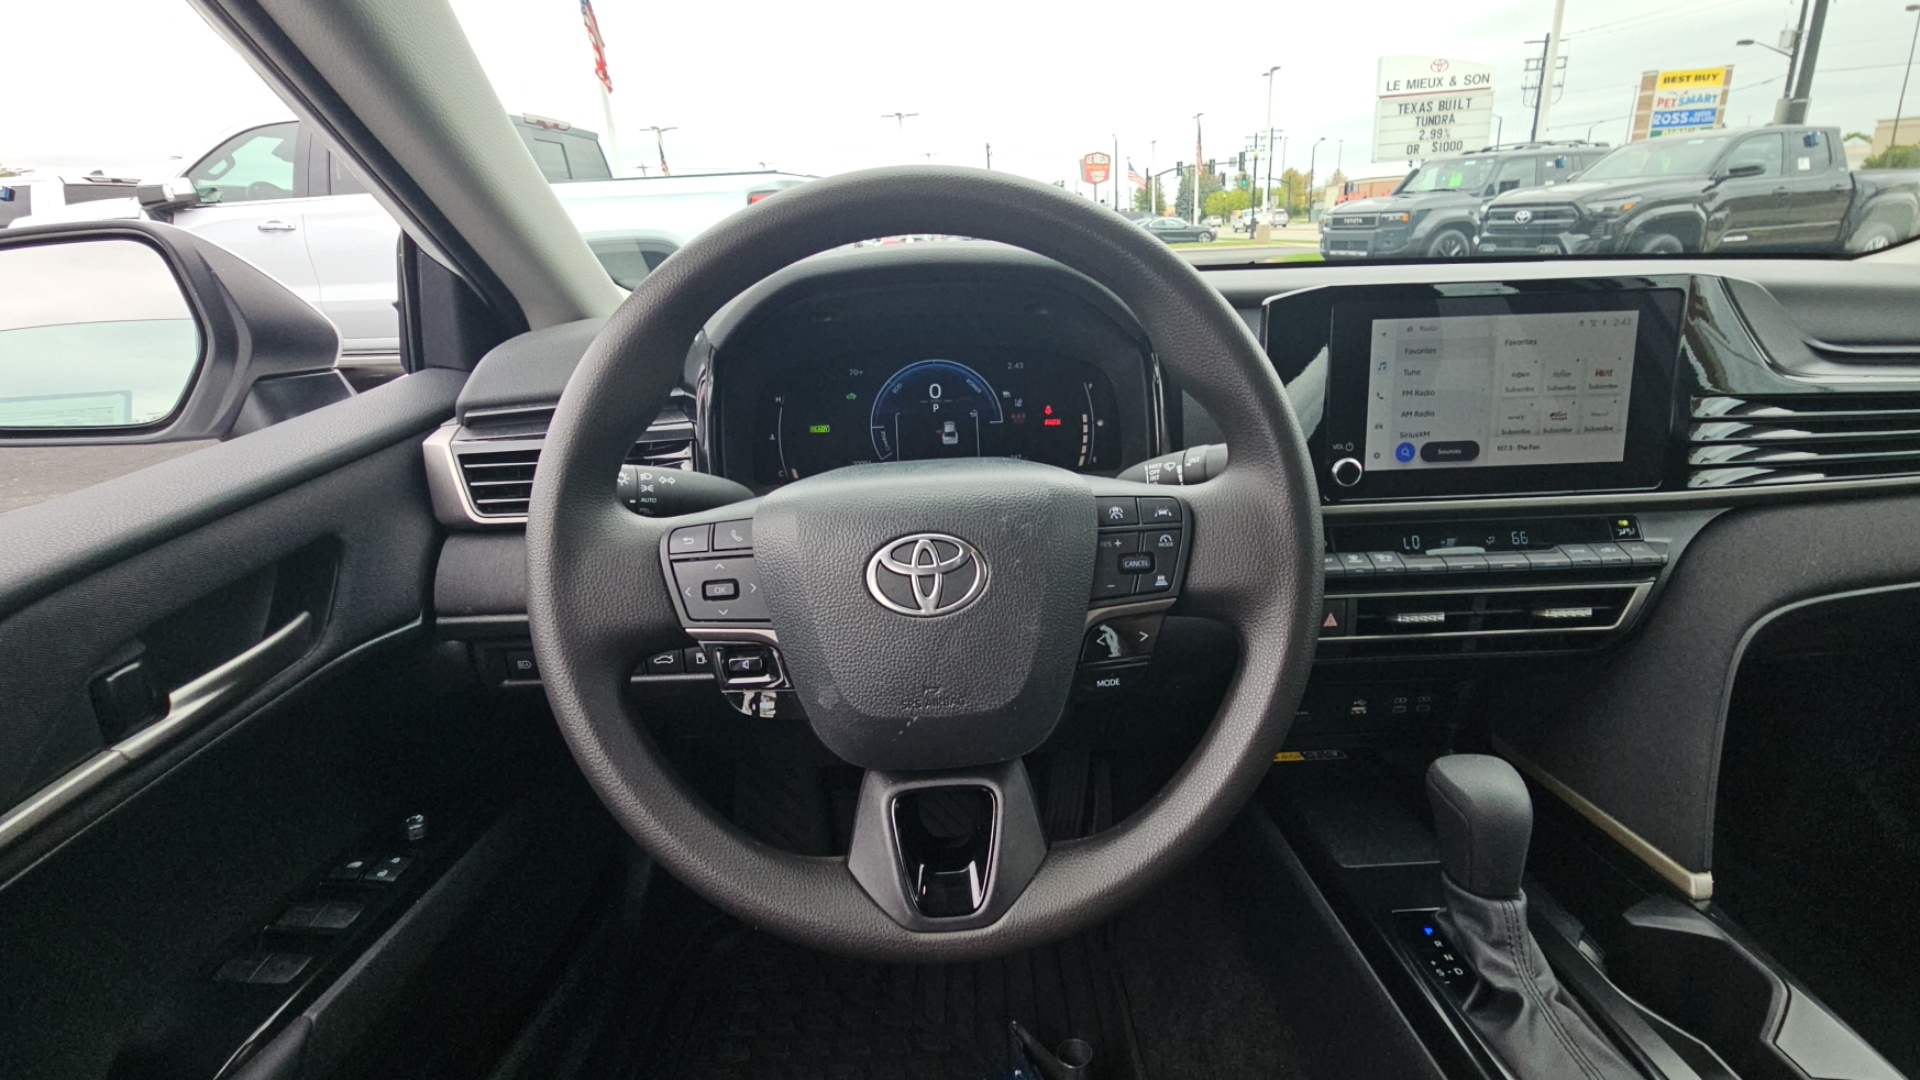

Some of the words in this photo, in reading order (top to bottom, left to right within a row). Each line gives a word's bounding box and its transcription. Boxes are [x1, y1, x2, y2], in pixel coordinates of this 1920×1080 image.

[1386, 80, 1401, 92] LE
[1406, 76, 1444, 90] MIEUX
[1449, 76, 1457, 87] &
[1463, 73, 1491, 86] SON
[1663, 74, 1692, 84] BEST
[1693, 72, 1719, 82] BUY
[1398, 100, 1433, 115] TEXAS
[1438, 98, 1473, 111] BUILT
[1415, 113, 1456, 127] TUNDRA
[1653, 112, 1690, 125] ROSS
[1419, 129, 1451, 141] 2.99%
[1406, 144, 1420, 155] OR
[1504, 337, 1538, 347] Favorites
[1404, 347, 1437, 356] Favorites
[1006, 362, 1024, 370] 2:43
[1403, 368, 1421, 377] Tune
[928, 384, 942, 399] 0
[1547, 384, 1576, 392] Subscribe
[1588, 383, 1618, 391] Subscribe
[1402, 389, 1414, 397] FM
[1416, 388, 1435, 397] Radio
[932, 404, 940, 413] P
[1401, 410, 1414, 419] AM
[1416, 409, 1435, 418] Radio
[1400, 429, 1431, 440] SiriusXM
[1517, 443, 1528, 451] The
[1529, 443, 1541, 451] Fan
[1403, 535, 1420, 550] LO
[1511, 531, 1529, 545] 66
[1124, 560, 1149, 568] CANCEL
[714, 587, 726, 595] OK
[1096, 678, 1120, 688] MODE
